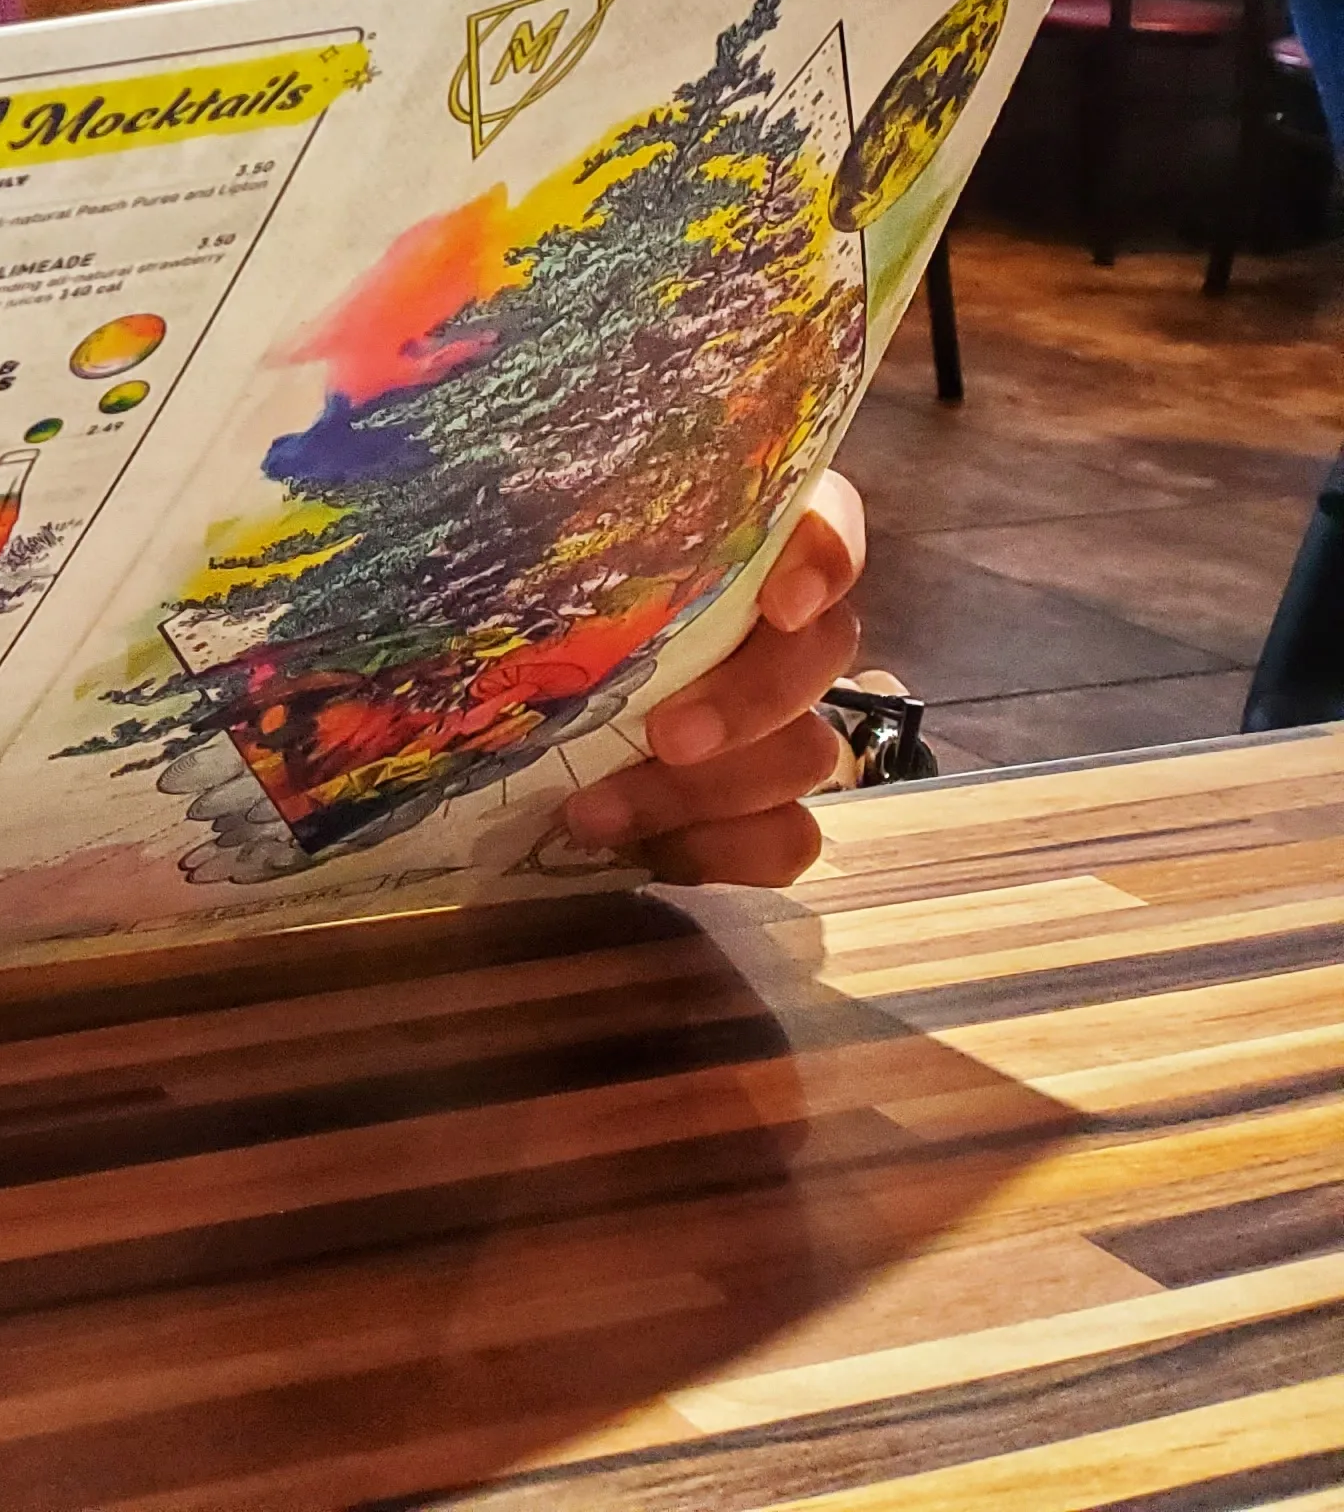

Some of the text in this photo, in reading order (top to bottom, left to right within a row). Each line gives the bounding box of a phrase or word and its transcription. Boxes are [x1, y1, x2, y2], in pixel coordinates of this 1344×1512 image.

[8, 70, 312, 152] Mocktails
[235, 160, 276, 177] 3.50
[75, 200, 128, 217] Peach
[184, 187, 215, 201] and
[197, 233, 237, 251] 3.50
[96, 281, 124, 294] cal
